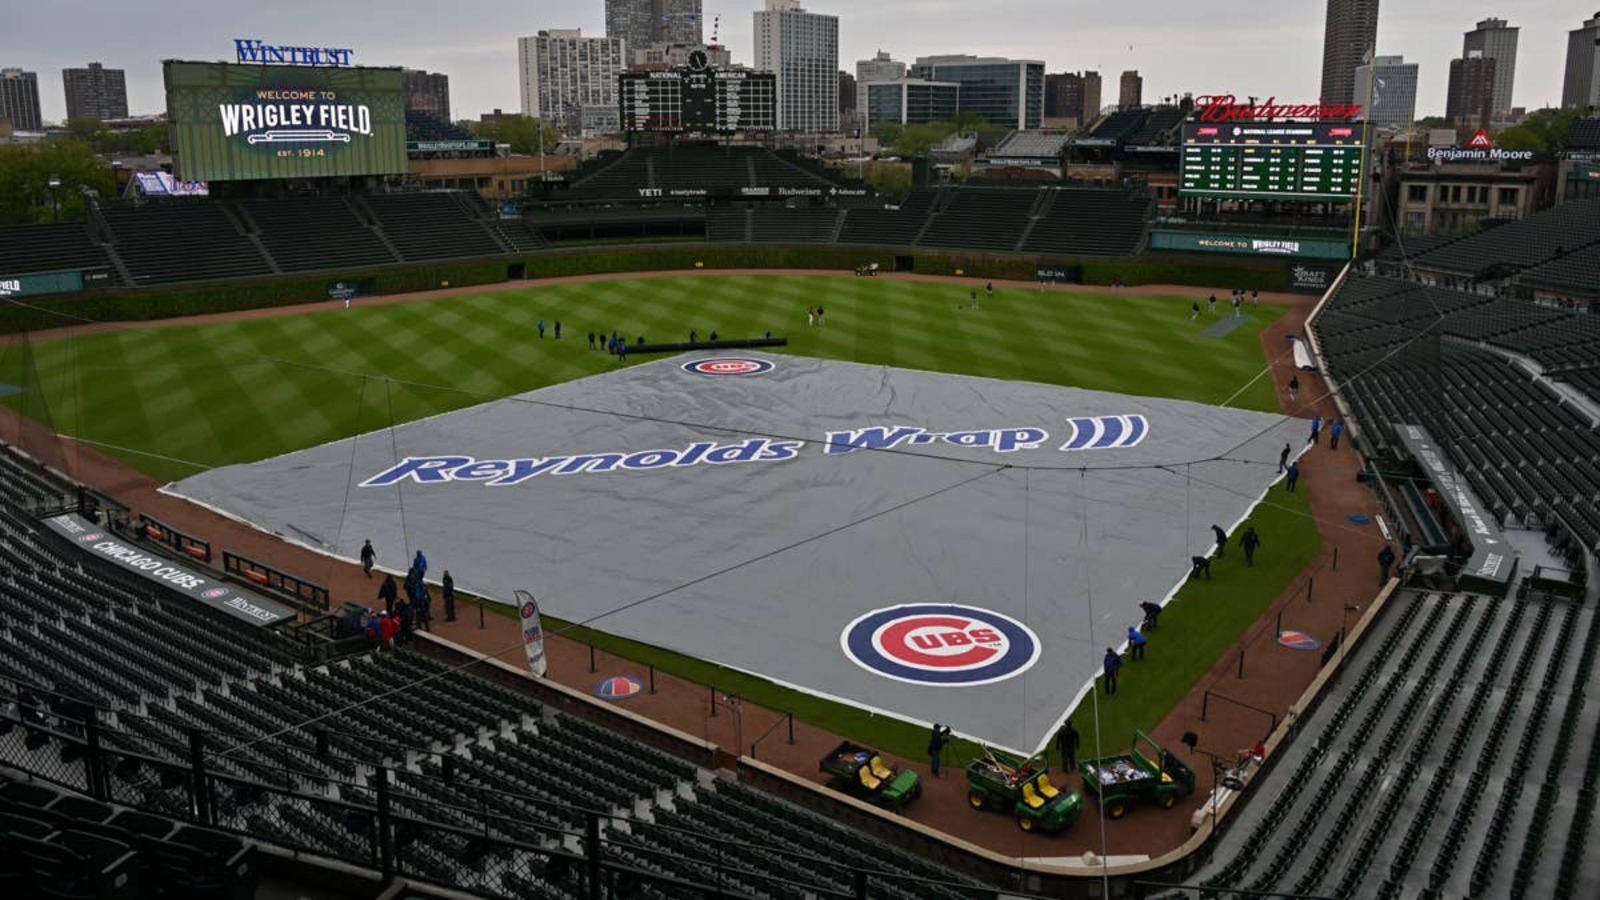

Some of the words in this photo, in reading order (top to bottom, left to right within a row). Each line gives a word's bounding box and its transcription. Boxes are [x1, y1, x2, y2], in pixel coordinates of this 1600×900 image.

[257, 91, 315, 100] WELCOME
[320, 92, 336, 100] TO
[1195, 94, 1363, 122] Budweiser
[219, 104, 314, 137] WRIGLEY
[299, 149, 325, 157] 1914
[1427, 147, 1486, 160] Benjamin
[1489, 148, 1533, 160] Moore
[638, 188, 662, 197] YETI
[778, 187, 822, 196] Budweiser
[1198, 240, 1234, 248] WELCOME
[1252, 240, 1280, 250] WRIGLEY
[1281, 240, 1299, 252] FIELD
[358, 439, 805, 487] Reynolds
[824, 426, 1049, 454] Wrap
[93, 540, 157, 571] CHICAGO
[153, 567, 204, 590] CUBS
